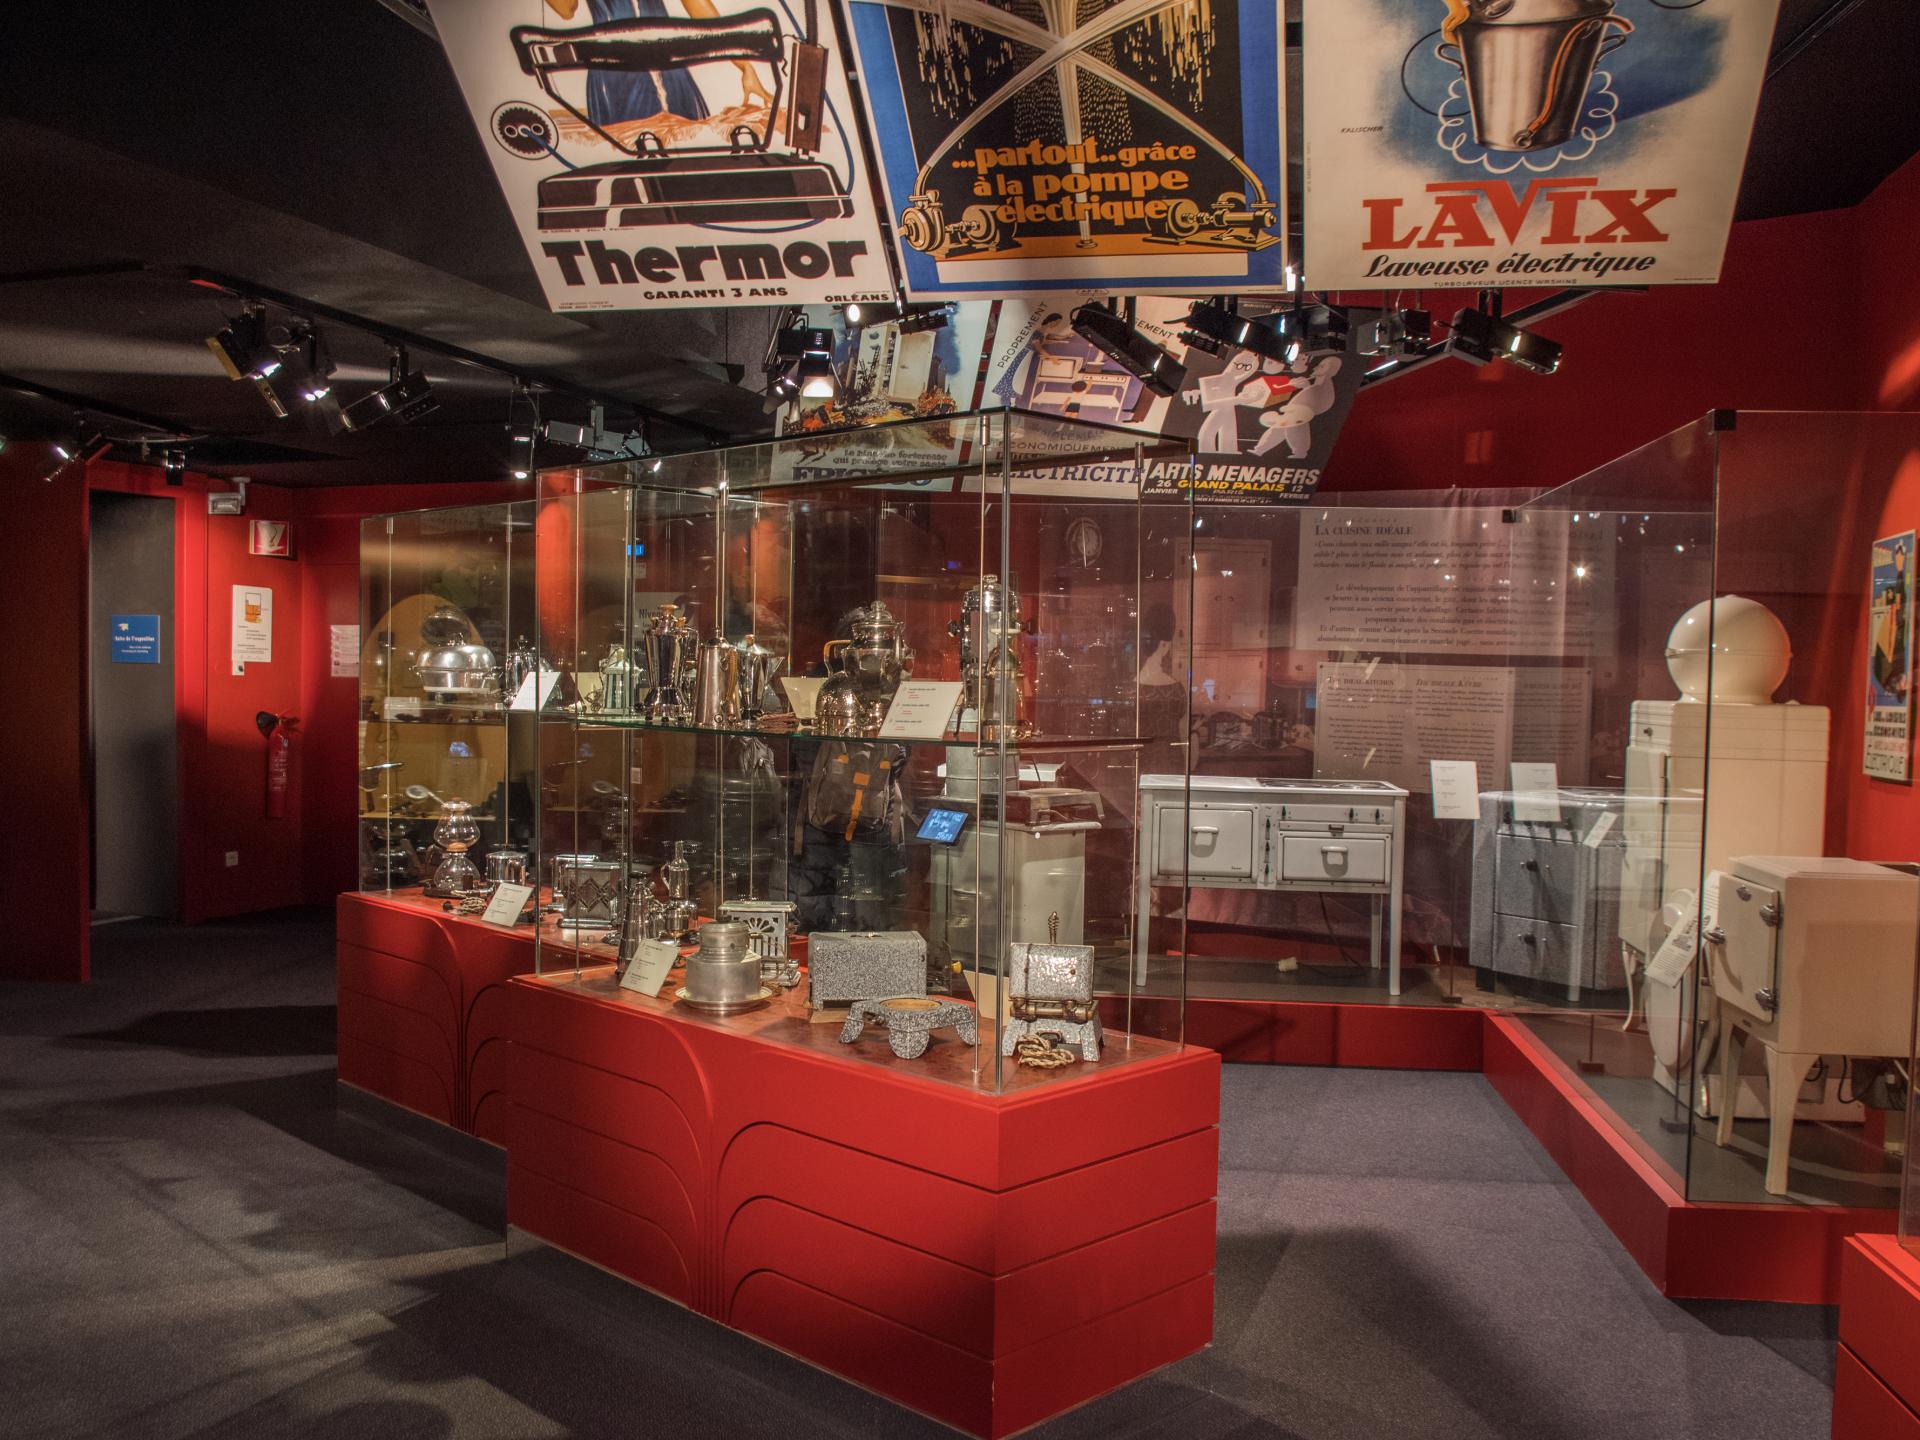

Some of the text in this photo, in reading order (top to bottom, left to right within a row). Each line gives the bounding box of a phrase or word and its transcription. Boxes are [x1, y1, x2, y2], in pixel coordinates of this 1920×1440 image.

[1340, 126, 1384, 134] KALISCHER
[1118, 141, 1196, 168] grâce
[973, 169, 1190, 200] à la pompe
[996, 196, 1168, 226] électrique
[1362, 177, 1678, 251] LAVIX
[541, 239, 869, 286] Thermor
[1362, 251, 1657, 278] Laveuse électrique
[643, 287, 789, 300] GARANTI 3 ANS
[824, 292, 890, 303] ORLÉANS
[997, 301, 1048, 369] PROPREMENT
[1148, 462, 1321, 486] ARTS MENAGERS
[1156, 480, 1172, 488] 26
[1177, 479, 1285, 492] GRAND PALAIS
[1291, 485, 1304, 493] 12
